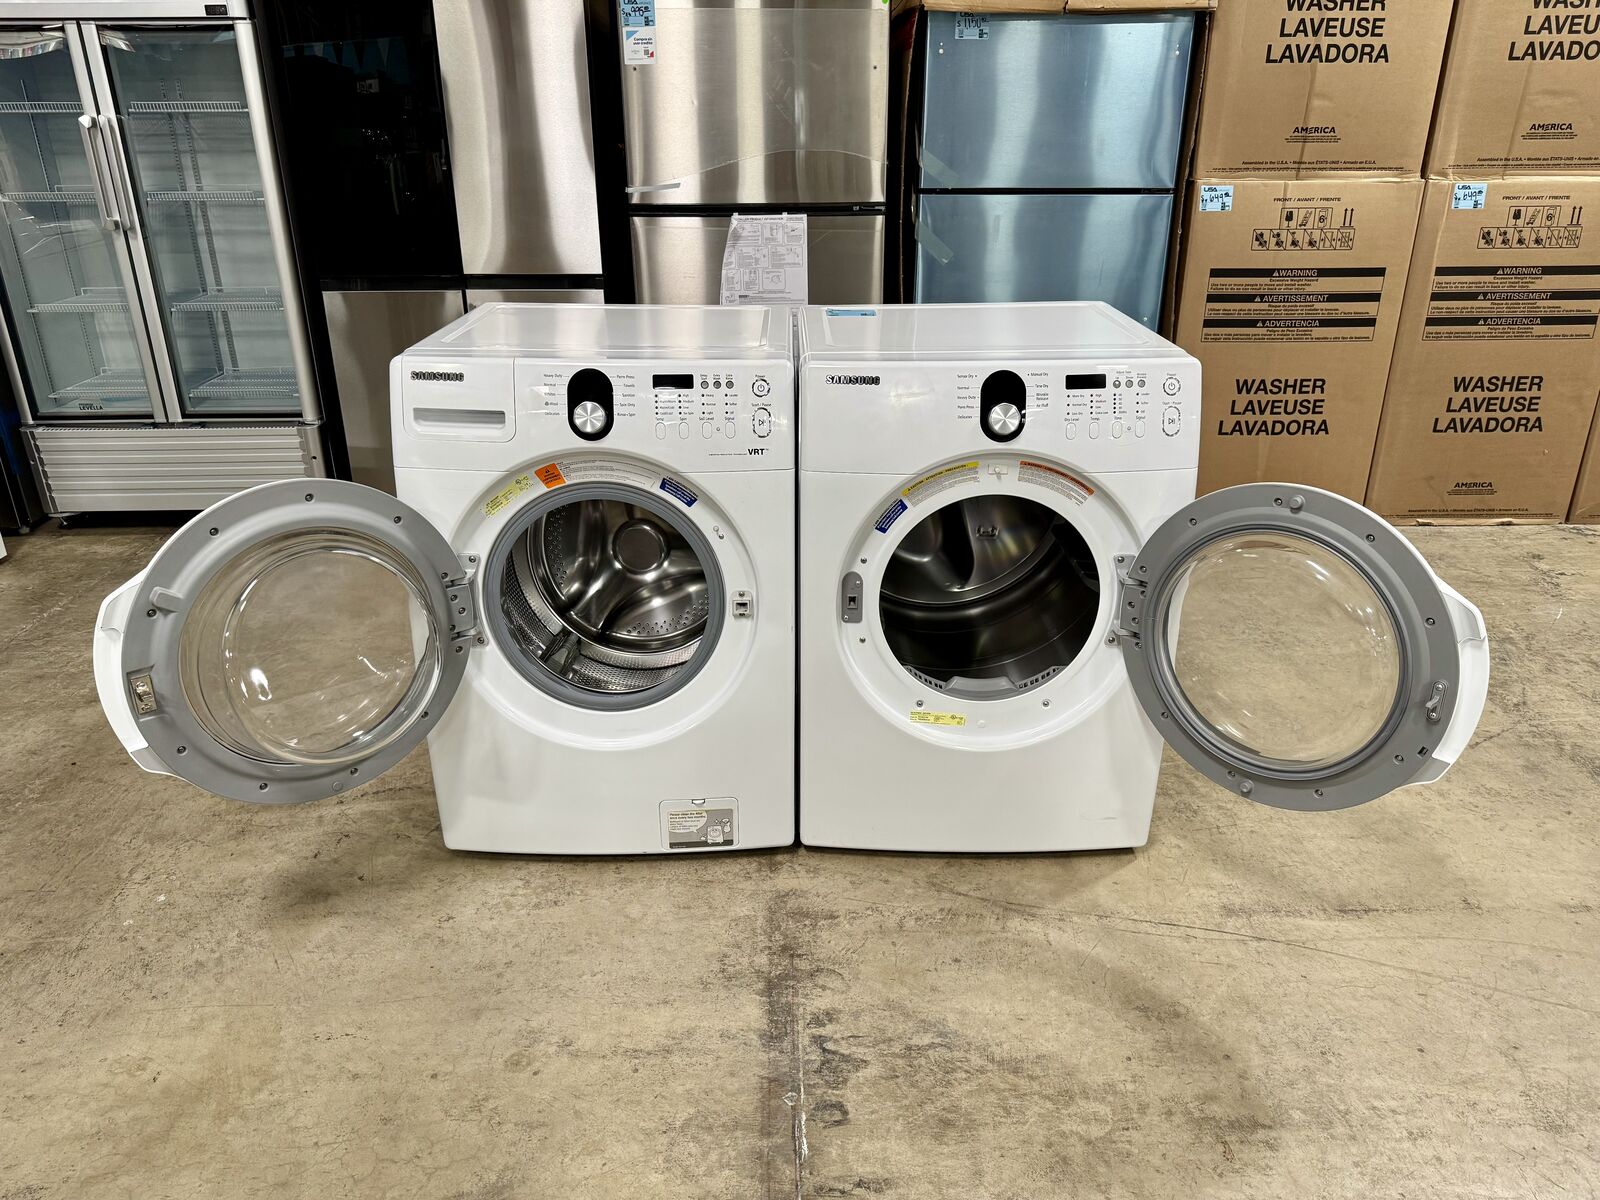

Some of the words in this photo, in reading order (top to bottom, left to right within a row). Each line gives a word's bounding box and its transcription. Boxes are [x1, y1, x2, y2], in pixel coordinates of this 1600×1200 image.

[1280, 18, 1385, 37] LAVEUSE
[1265, 44, 1389, 64] LAVADORA
[1508, 41, 1600, 61] LAVADO
[1293, 126, 1336, 134] AMERICA
[1530, 123, 1572, 131] AMERICA
[411, 371, 464, 382] SAMSUNG
[826, 375, 881, 385] SAMSUNG
[1453, 376, 1544, 392] WASHER
[1235, 378, 1326, 394] WASHER
[1230, 399, 1325, 415] LAVEUSE
[1446, 396, 1541, 412] LAVEUSE
[1217, 420, 1329, 436] LAVADORA
[1432, 417, 1543, 433] LAVADORA
